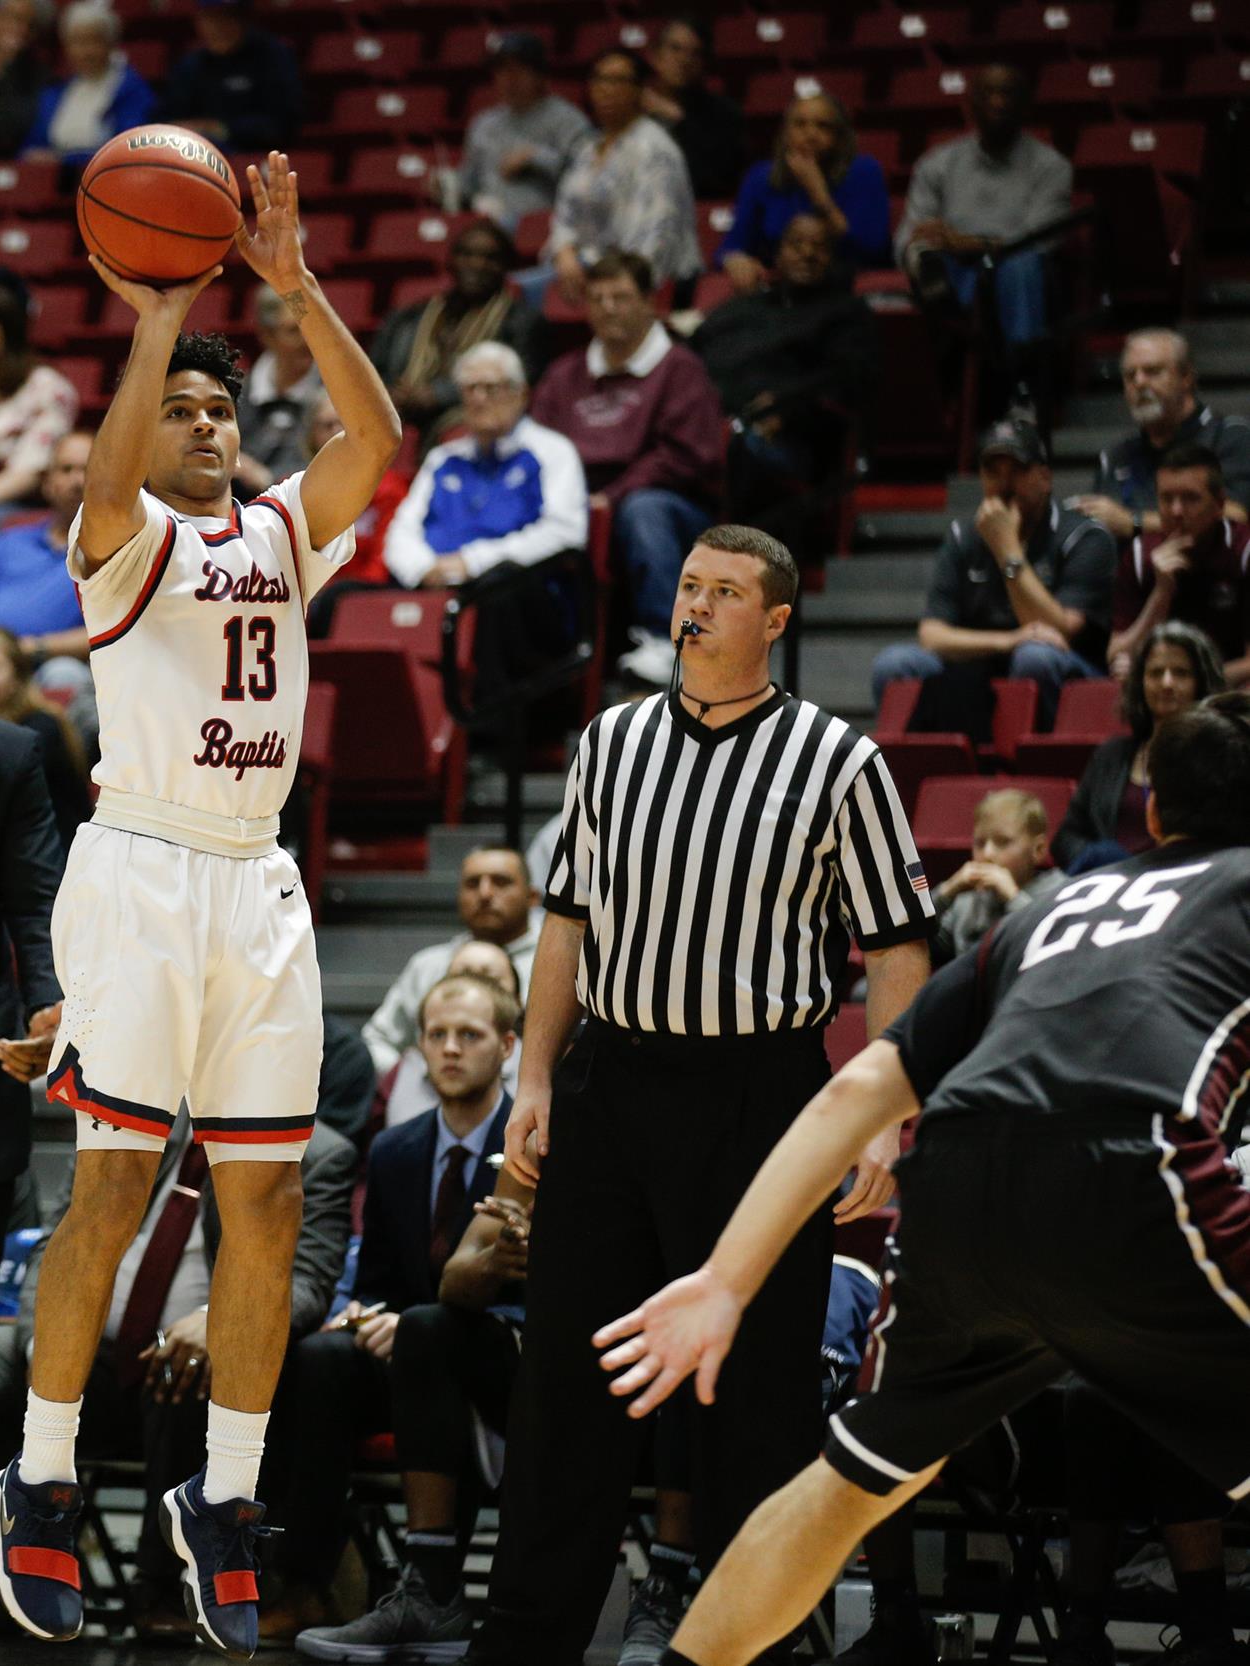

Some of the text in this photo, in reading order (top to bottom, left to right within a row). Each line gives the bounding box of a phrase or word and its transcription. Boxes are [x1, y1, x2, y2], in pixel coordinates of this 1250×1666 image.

[194, 559, 290, 603] Dallas
[221, 615, 277, 702] 13
[193, 717, 291, 781] Baptis
[1018, 861, 1213, 972] 25
